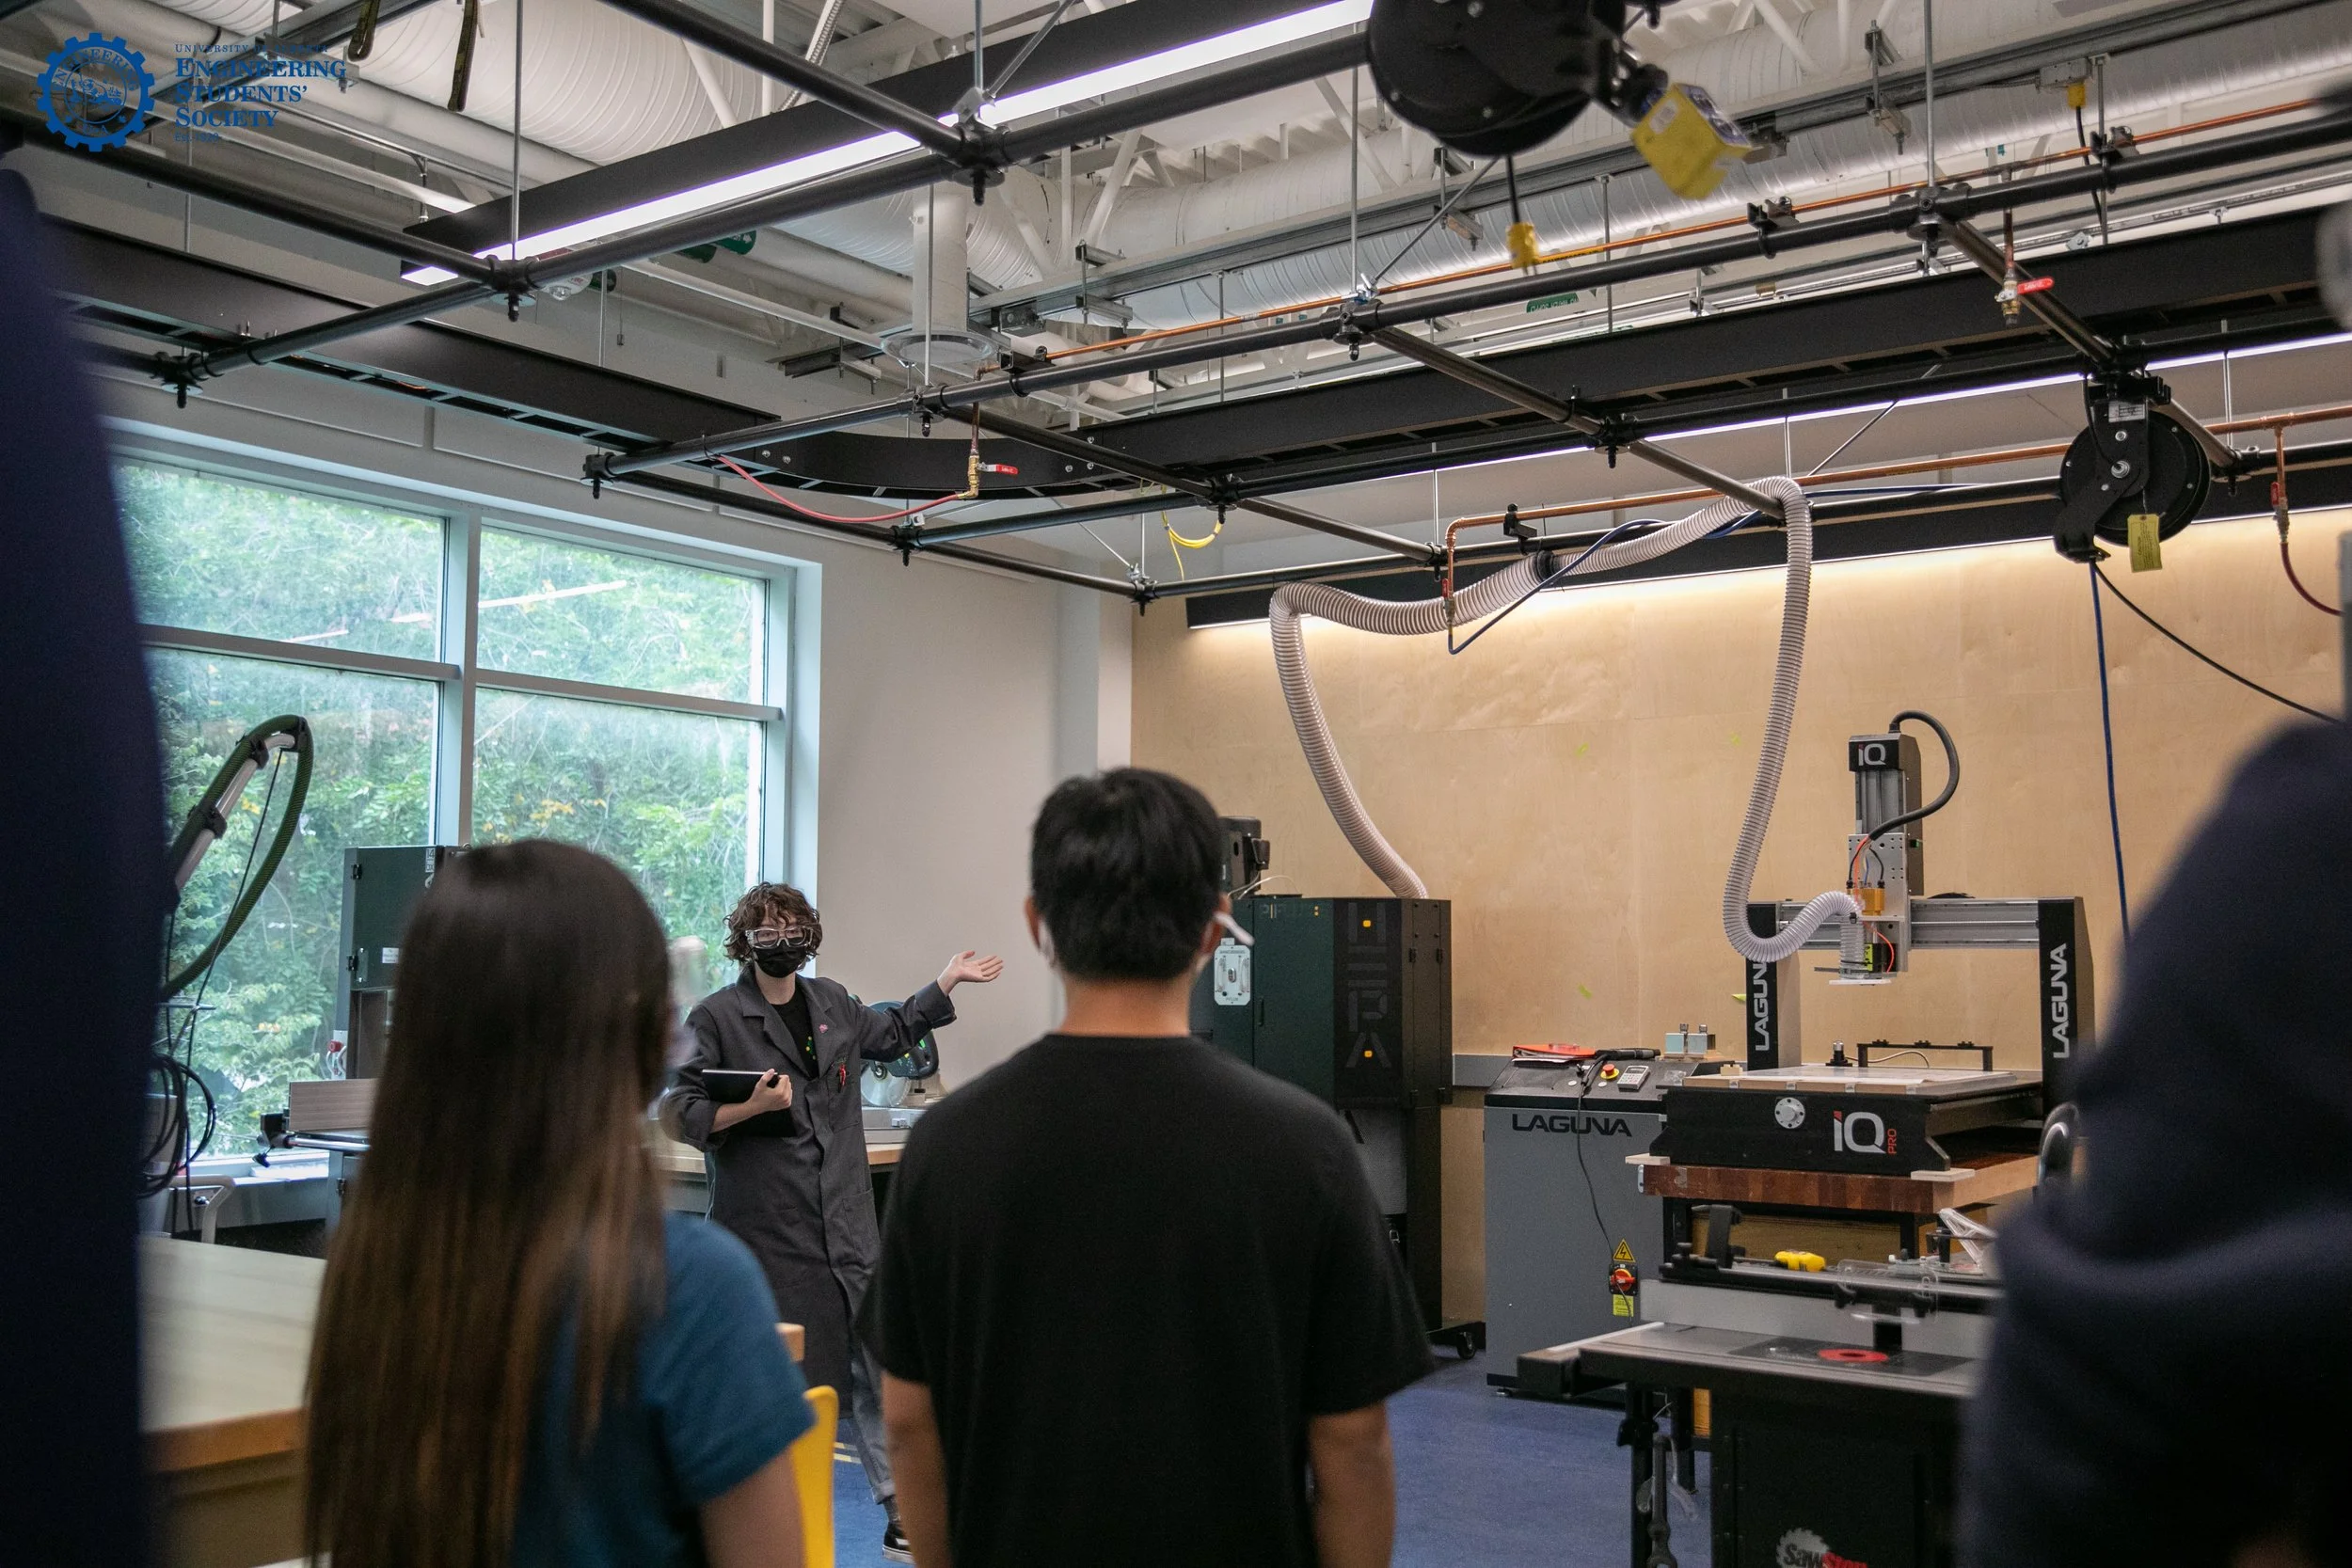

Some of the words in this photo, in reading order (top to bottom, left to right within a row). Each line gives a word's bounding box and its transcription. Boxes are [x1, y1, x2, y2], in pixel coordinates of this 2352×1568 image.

[1753, 959, 1770, 1051] LAGUN
[2049, 942, 2070, 1059] LAGUNA
[1512, 1113, 1632, 1137] LAGUNA
[1833, 1110, 1886, 1153] iQ
[1886, 1128, 1898, 1155] PRO
